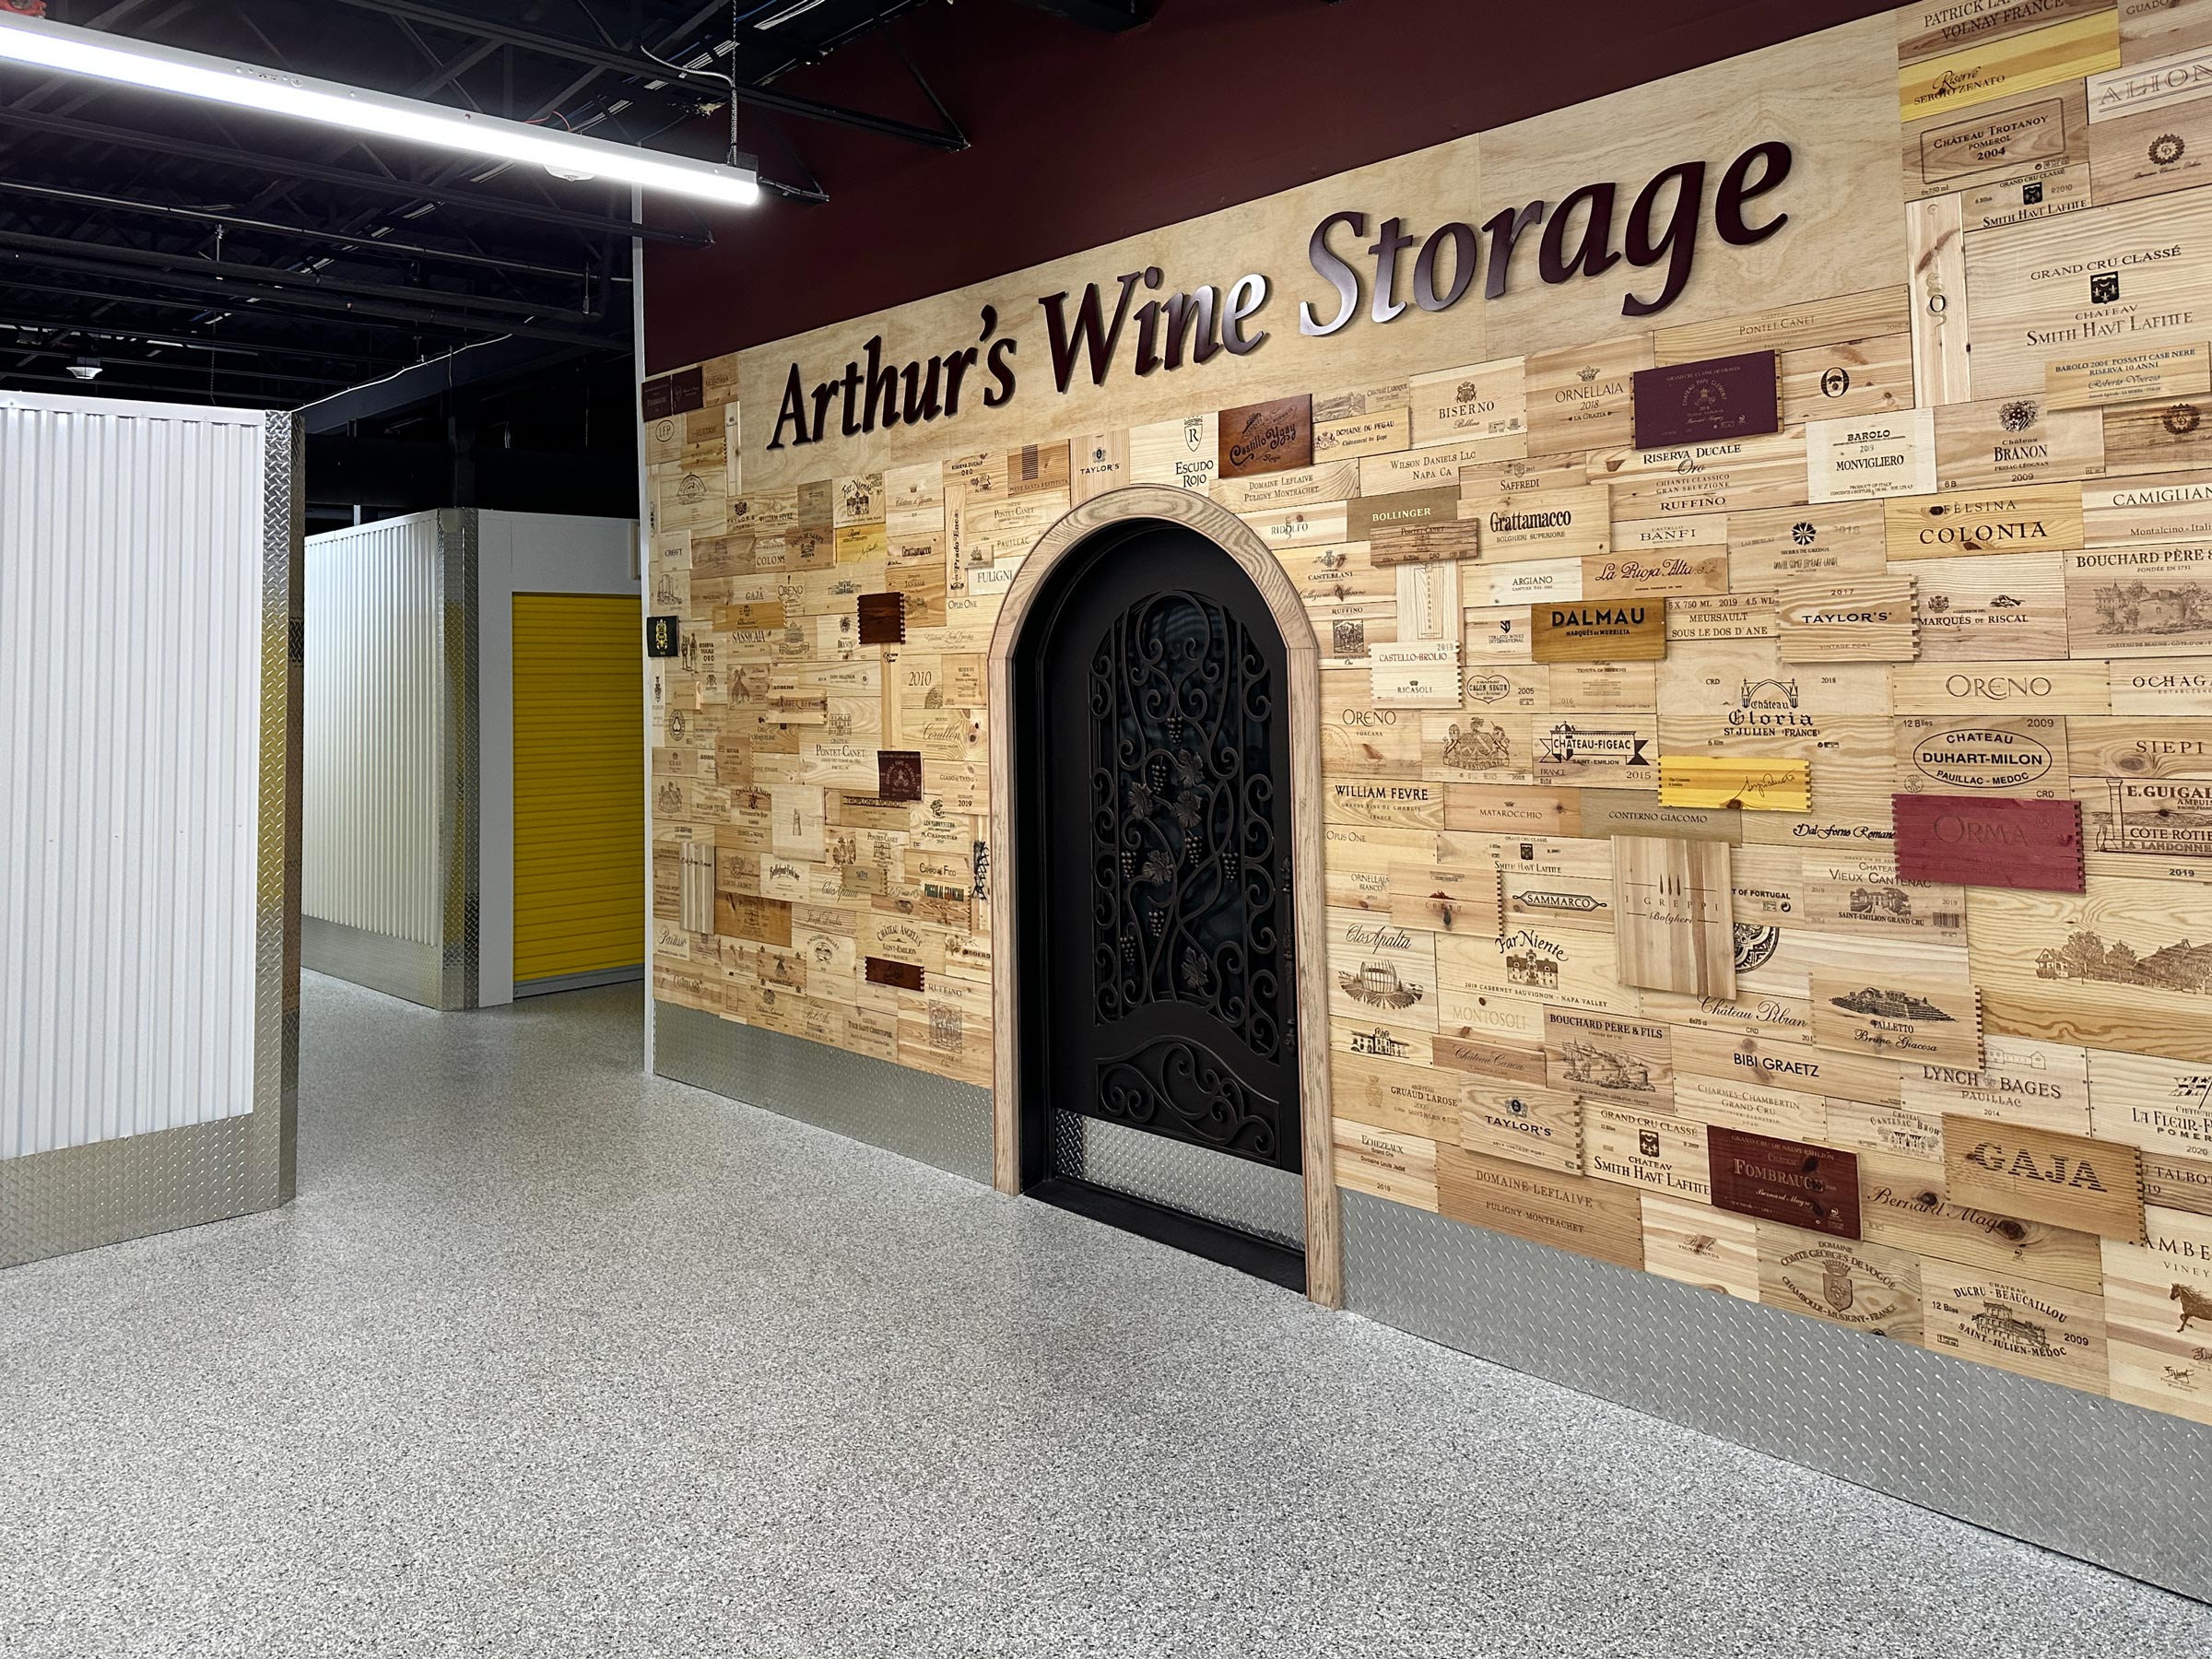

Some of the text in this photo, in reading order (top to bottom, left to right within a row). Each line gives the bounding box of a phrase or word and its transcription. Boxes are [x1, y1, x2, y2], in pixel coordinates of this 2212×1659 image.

[1924, 2, 1983, 28] PATRICK
[1941, 0, 2065, 40] VOLNAY FRANCE
[1914, 76, 2006, 106] SERGIO ZENATO
[1988, 114, 2048, 136] TROTANOY
[1969, 135, 2012, 151] POMEROL
[1977, 147, 2006, 161] 2004
[1999, 178, 2022, 188] GRAND
[2024, 174, 2038, 182] CRU
[2030, 245, 2182, 281] GRAND CRU CLASSÉ
[766, 140, 1794, 451] Arthur's Wine Storage
[2027, 329, 2077, 347] SMITH
[2130, 312, 2193, 331] LAFITTE
[2089, 361, 2159, 376] RISERVA 10 ANNI
[1555, 383, 1623, 403] ORNELLAIA
[1439, 401, 1495, 419] BISERNO
[1580, 400, 1599, 410] 2018
[1583, 411, 1606, 420] GRAZIA
[1189, 429, 1198, 442] R
[1847, 429, 1890, 441] BAROLO
[1643, 444, 1742, 464] RISERVA DUCALE
[1860, 444, 1875, 453] 2019
[1994, 444, 2047, 462] BRANON
[1176, 460, 1214, 475] ESCUDO
[1391, 458, 1420, 469] WILSON
[1423, 454, 1457, 465] DANIELS
[1836, 454, 1905, 471] MONVIGLIERO
[1080, 463, 1121, 475] TAYLOR'S
[1413, 470, 1436, 480] NAPA
[1182, 475, 1206, 488] ROJO
[1249, 475, 1313, 489] DOMAINE LEFLAIVE
[1500, 478, 1539, 491] SAFFREDI
[1656, 475, 1730, 487] CHIANTI CLASSICO
[2011, 473, 2034, 482] 2009
[1244, 486, 1319, 502] PULIGNY MONTRACHET
[1656, 482, 1730, 494] GRAN SELEZIONE
[1661, 497, 1725, 511] RUFFINO
[1371, 508, 1431, 522] BOLLINGER
[1490, 510, 1571, 533] Grattamacco
[1496, 531, 1565, 543] BOLGHERI SUPERIORE
[1641, 528, 1696, 540] BANFI
[1920, 522, 2047, 544] COLONIA
[997, 537, 1030, 547] PAUILLAC
[2077, 548, 2203, 568] BOUCHARD PÈRE
[977, 571, 1012, 582] FULIGNI
[1595, 562, 1616, 581] La
[1621, 560, 1661, 581] Rioja
[1512, 575, 1553, 586] ARGIANO
[1552, 607, 1645, 627] DALMAU
[1689, 613, 1747, 622] MEURSAULT
[1802, 612, 1888, 624] TAYLOR'S
[1920, 613, 1971, 626] MARQUÉS
[1988, 614, 2029, 624] RISCAL
[908, 671, 932, 687] 2010
[1518, 687, 1534, 695] 2005
[1945, 675, 2052, 700] ORENO
[1750, 700, 1789, 710] Château
[1343, 710, 1396, 727] ORENO
[1728, 710, 1814, 726] Gloria
[2028, 719, 2054, 728] 2009
[1947, 733, 2013, 744] CHATEAU
[2136, 740, 2203, 753] SIEPI
[1923, 752, 2042, 765] DUHART-MILON
[1626, 771, 1652, 780] 2015
[1936, 770, 2029, 784] PAUILLAC MEDOC
[1335, 785, 1429, 801] WILLIAM FEVRE
[2036, 790, 2054, 798] CRD
[1479, 809, 1543, 819] MATAROCCHIO
[1608, 811, 1708, 823] CONTERNO GIACOMO
[1326, 830, 1367, 842] OPUS ONE
[1936, 815, 2029, 846] ORMA
[1829, 868, 1931, 888] VIEUX CANTENAC
[2169, 868, 2194, 877] 2019
[1527, 895, 1591, 908] SAMMARCO
[1750, 890, 1791, 900] PORTUGAL
[1838, 912, 1888, 923] SAINT-EMILION
[1888, 917, 1910, 925] GRAND
[928, 983, 962, 996] RUFFINO
[1479, 984, 1512, 994] CABERNET
[1514, 990, 1554, 1000] SAUVIGNON
[1581, 998, 1607, 1007] VALLEY
[1453, 1007, 1525, 1030] MONTOSOLI
[1549, 1014, 1663, 1040] BOUCHARD PÈRE & FILS
[1734, 1053, 1819, 1077] BIBI GRAETZ
[1923, 1066, 2062, 1099] LYNCH BAGES
[1391, 1087, 1457, 1107] GRUAUD LAROSE
[1961, 1090, 2021, 1108] PAUILLAC
[1722, 1099, 1747, 1112] GRAND
[1749, 1103, 1776, 1116] CRU
[1484, 1114, 1553, 1137] TAYLOR'S
[1600, 1110, 1635, 1124] GRAND
[1637, 1116, 1658, 1128] CRU
[2186, 1146, 2208, 1156] 2020
[1973, 1142, 2108, 1193] GAJA
[1734, 1158, 1824, 1192] FOMBRAUGE
[1376, 1182, 1391, 1193] 2019
[1476, 1170, 1593, 1208] DOMAINE LEFLAIVE
[1818, 1241, 1853, 1253] DOMAINE
[1953, 1287, 2068, 1324] DUCRU BEAUCAILLOU
[2064, 1333, 2089, 1347] 2009
